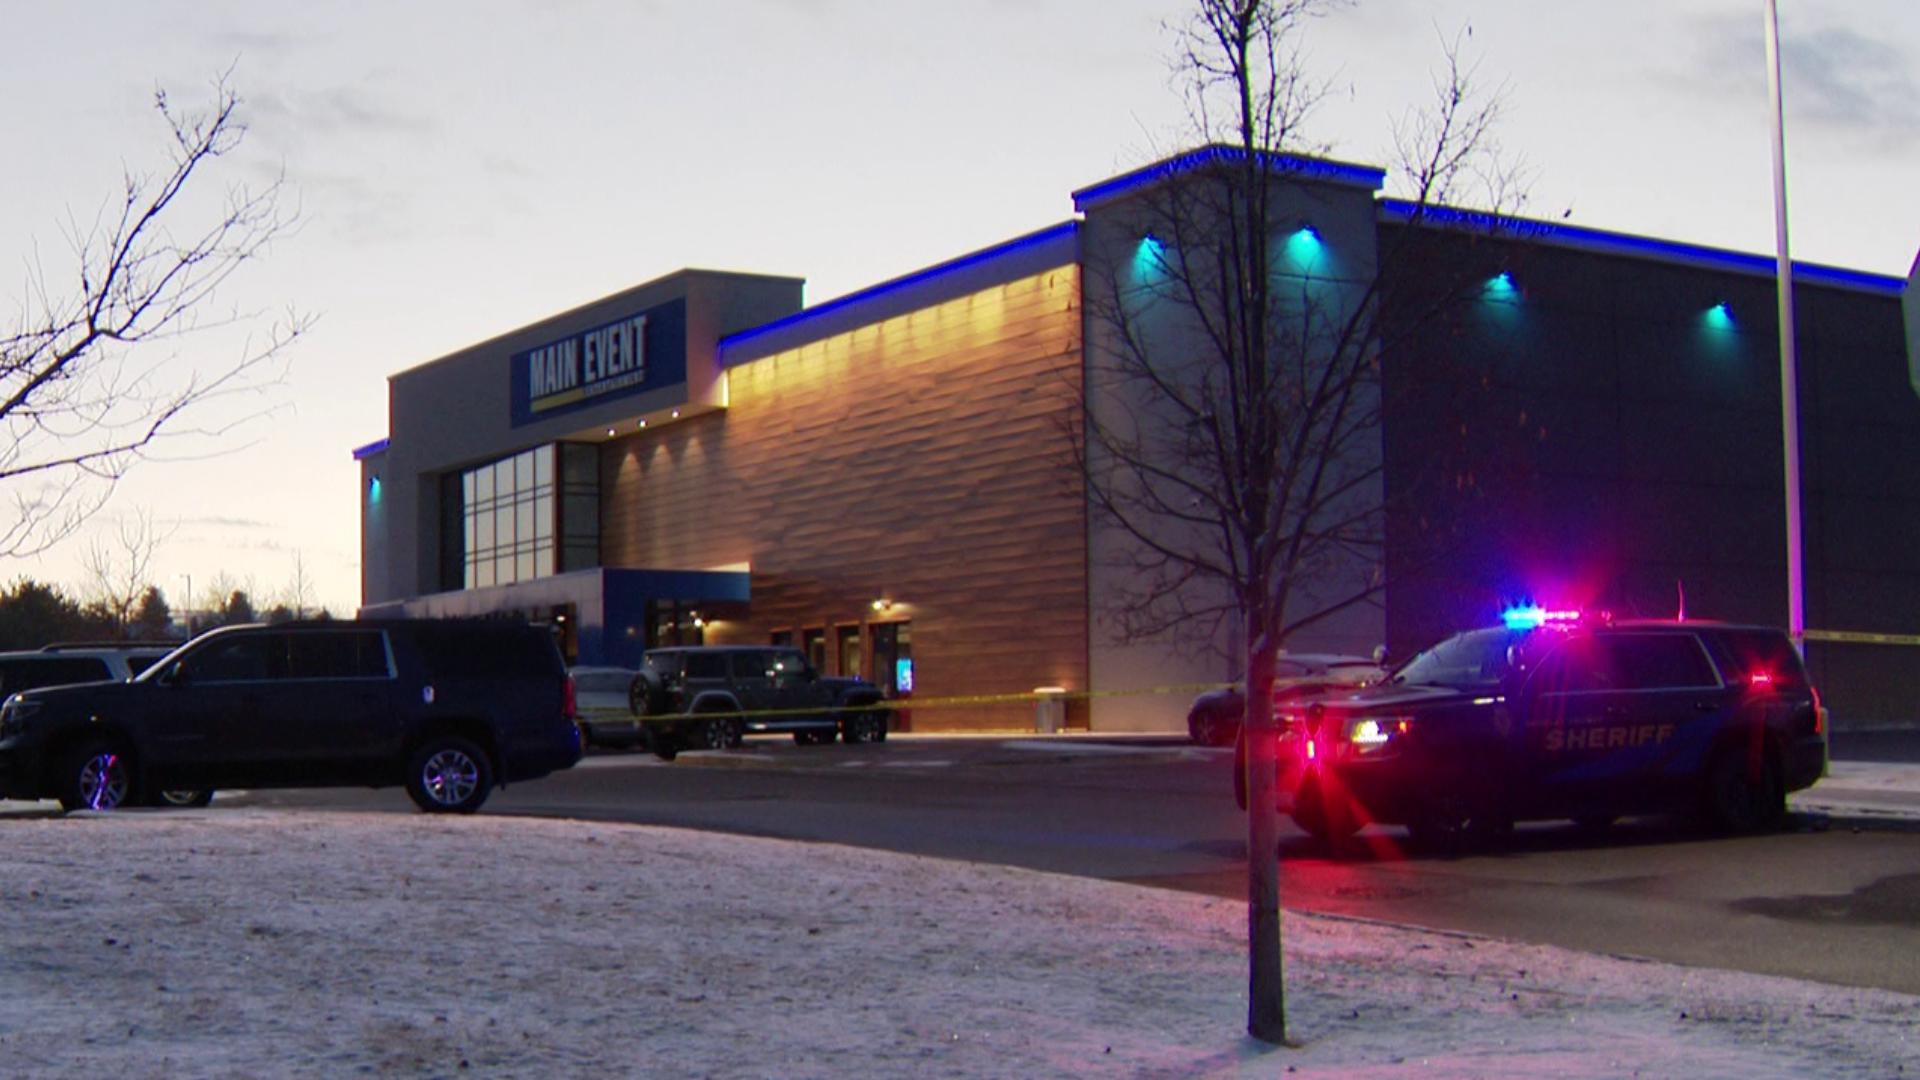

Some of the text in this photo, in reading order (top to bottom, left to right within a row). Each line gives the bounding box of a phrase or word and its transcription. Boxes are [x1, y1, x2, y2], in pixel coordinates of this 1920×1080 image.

[529, 338, 578, 400] MAIN
[584, 315, 648, 383] EVENT
[1544, 723, 1676, 751] SHERIFF
